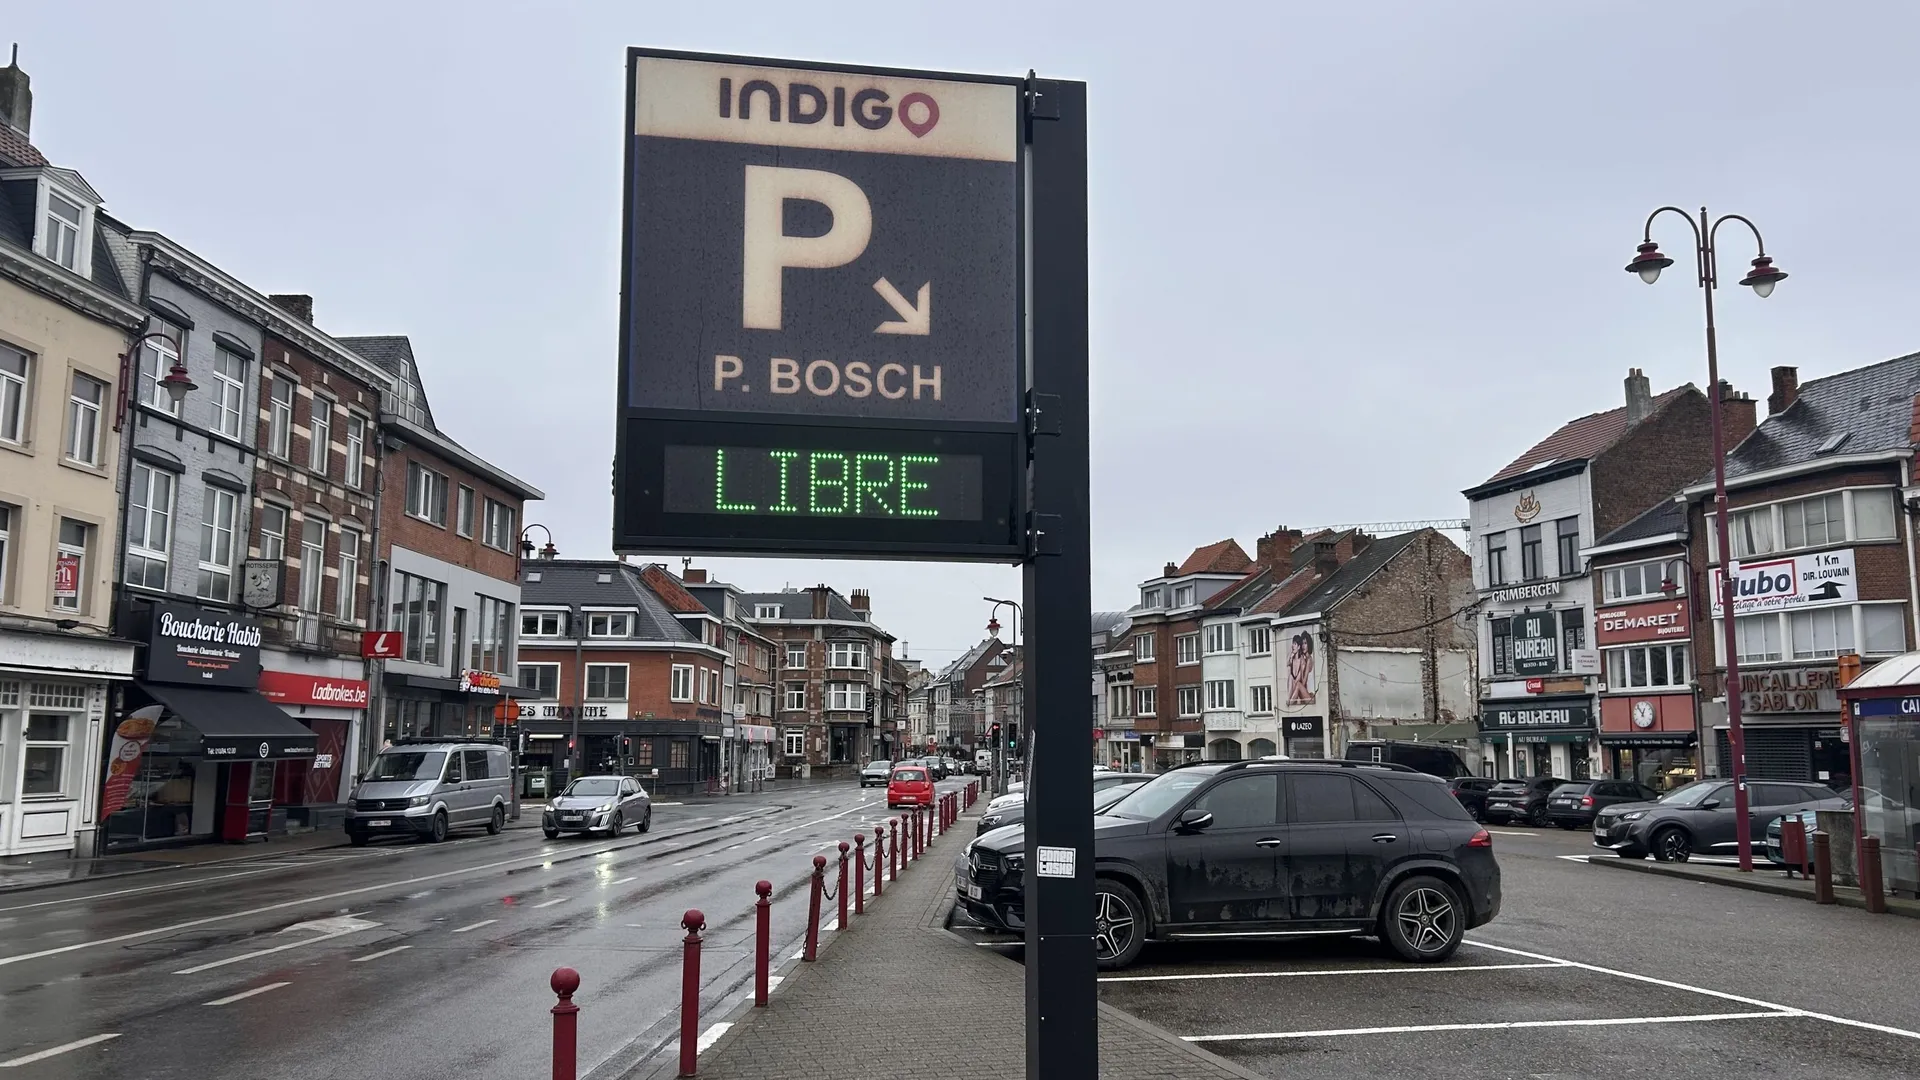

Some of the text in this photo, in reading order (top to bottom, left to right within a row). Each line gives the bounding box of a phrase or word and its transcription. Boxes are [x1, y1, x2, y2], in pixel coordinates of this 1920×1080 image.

[742, 164, 872, 331] P
[714, 355, 942, 401] P. BOSCH
[715, 448, 940, 516] LIBRE
[1815, 555, 1839, 567] 1 Km
[1803, 567, 1850, 582] DIR. LOUVAIN
[1491, 582, 1560, 602] GRIMBERGEN
[1763, 596, 1781, 607] votre
[1599, 611, 1626, 619] HORLOGERIE
[1603, 613, 1678, 631] DEMARET
[161, 612, 261, 647] Boucherie Habib
[1526, 618, 1540, 637] AU
[1657, 626, 1685, 635] BIJOUTERIE
[1514, 637, 1555, 659] BUREAU
[312, 682, 366, 702] Ladbrokes.be
[1750, 692, 1819, 711] SABLON
[1499, 709, 1570, 724] AU BUREAU
[1296, 722, 1312, 731] LAZEO
[315, 754, 332, 762] SPORTS
